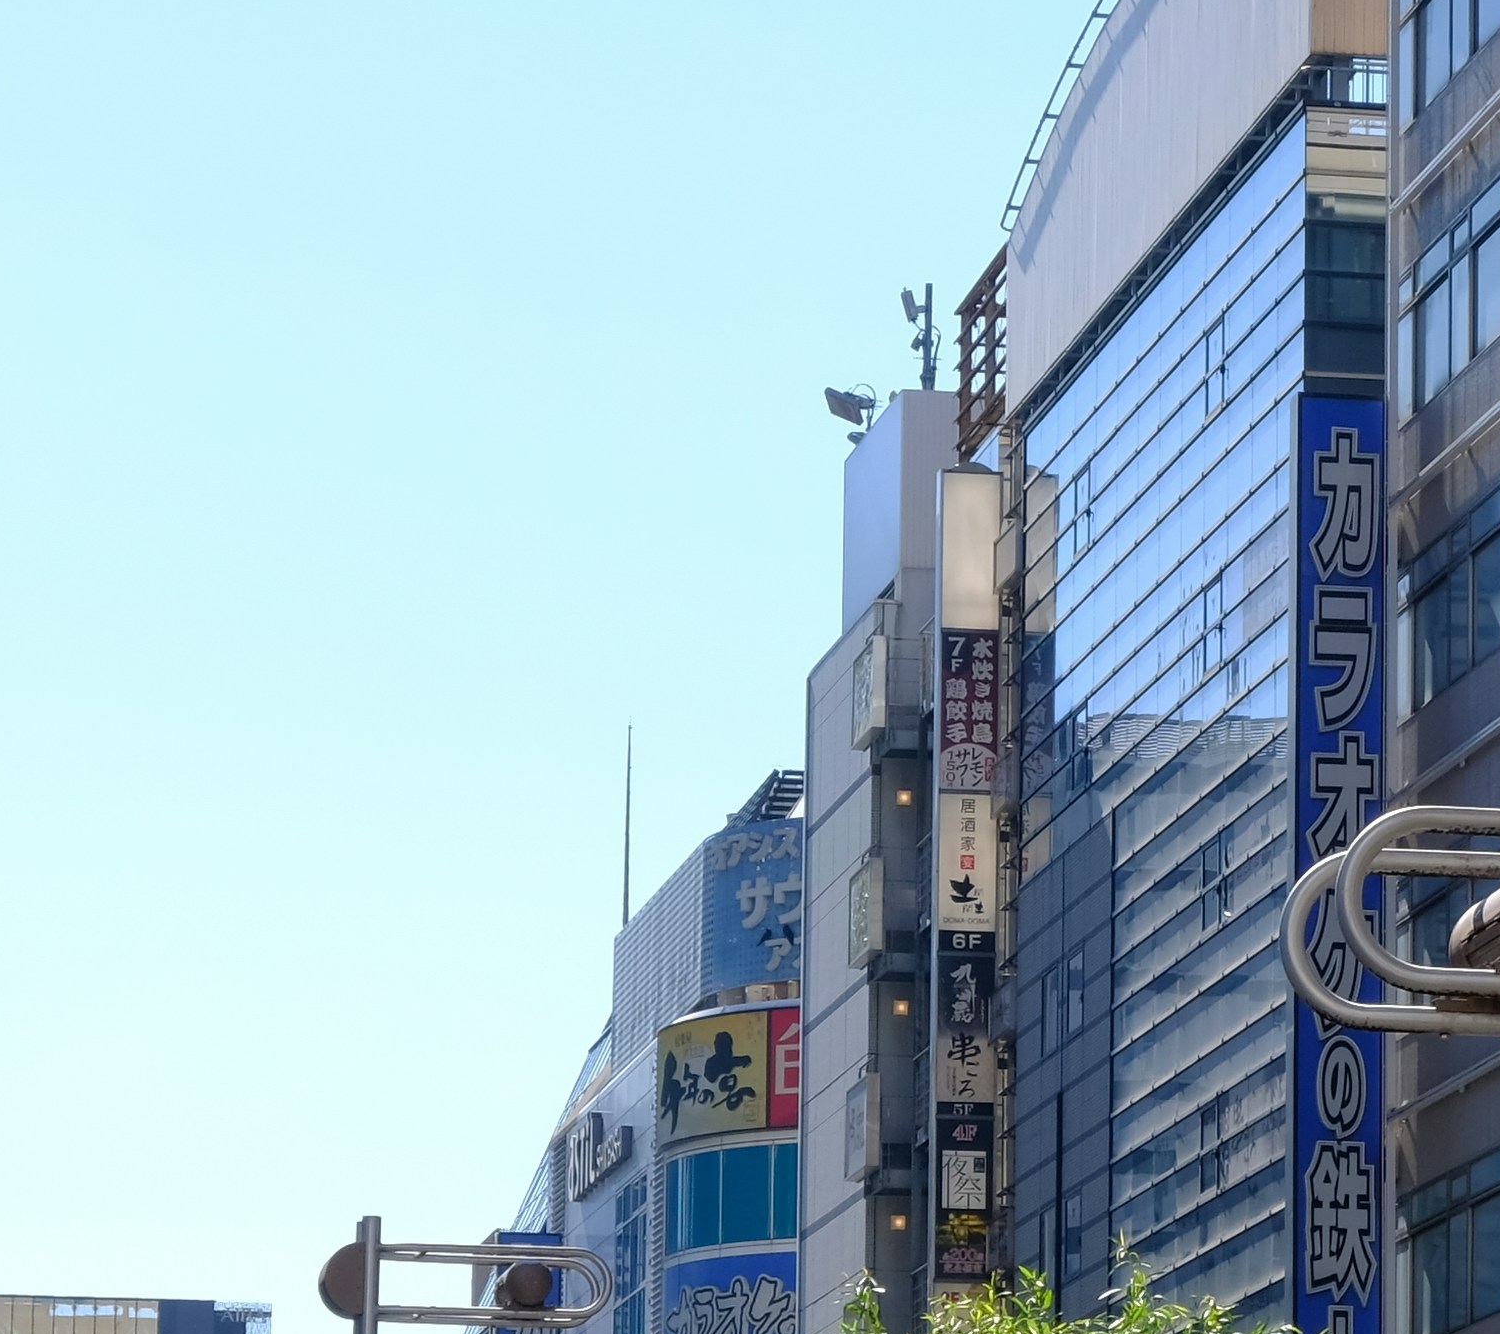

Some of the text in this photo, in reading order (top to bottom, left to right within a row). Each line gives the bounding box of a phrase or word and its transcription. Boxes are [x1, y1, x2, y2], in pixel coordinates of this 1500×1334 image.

[971, 637, 994, 744] 水炊き焼鳥
[945, 678, 968, 744] 鶏餃子
[954, 749, 971, 788] サワー
[969, 747, 984, 788] レモン
[952, 933, 983, 950] 6F
[953, 1103, 975, 1116] 5F
[952, 1123, 979, 1142] 4F
